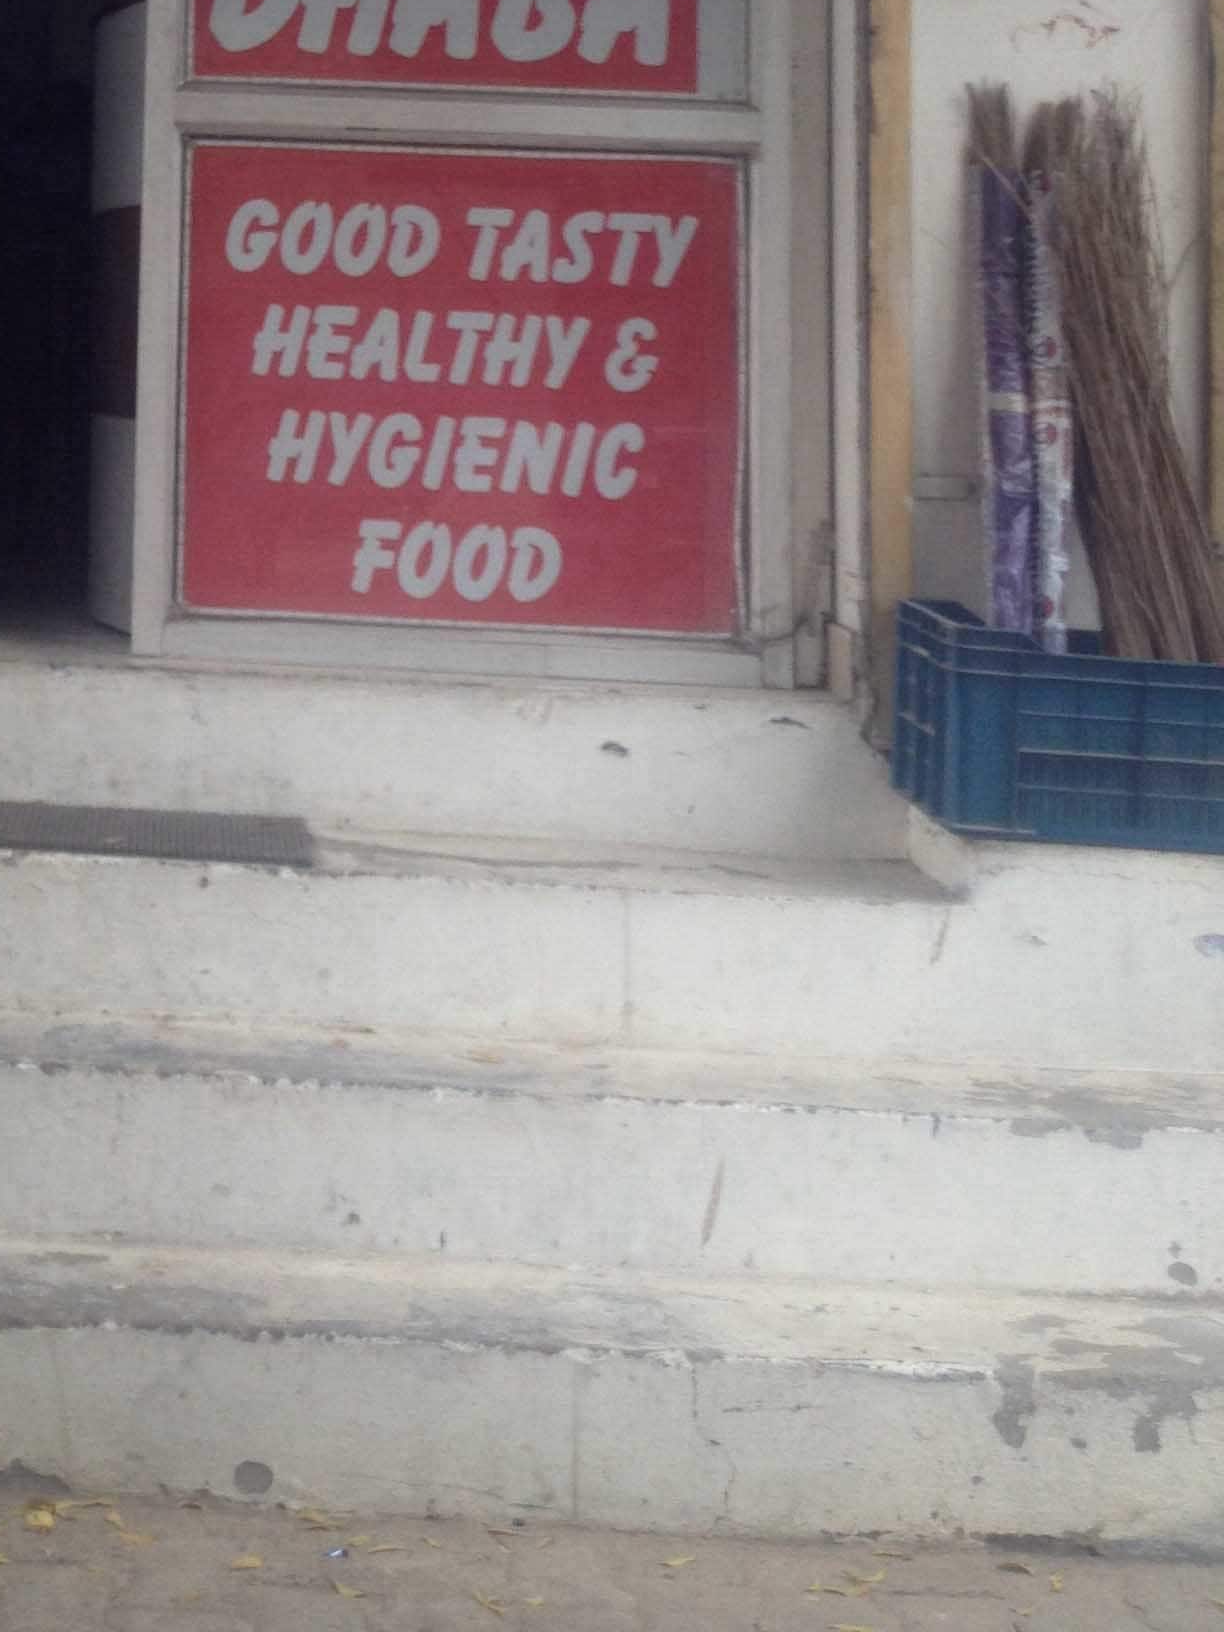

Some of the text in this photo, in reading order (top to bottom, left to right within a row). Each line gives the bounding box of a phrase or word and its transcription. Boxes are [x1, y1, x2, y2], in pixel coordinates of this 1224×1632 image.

[225, 198, 699, 288] GOOD TASTY
[251, 304, 660, 393] HEALTHY &
[266, 408, 645, 500] HYGIENIC
[351, 519, 564, 603] FOOD
